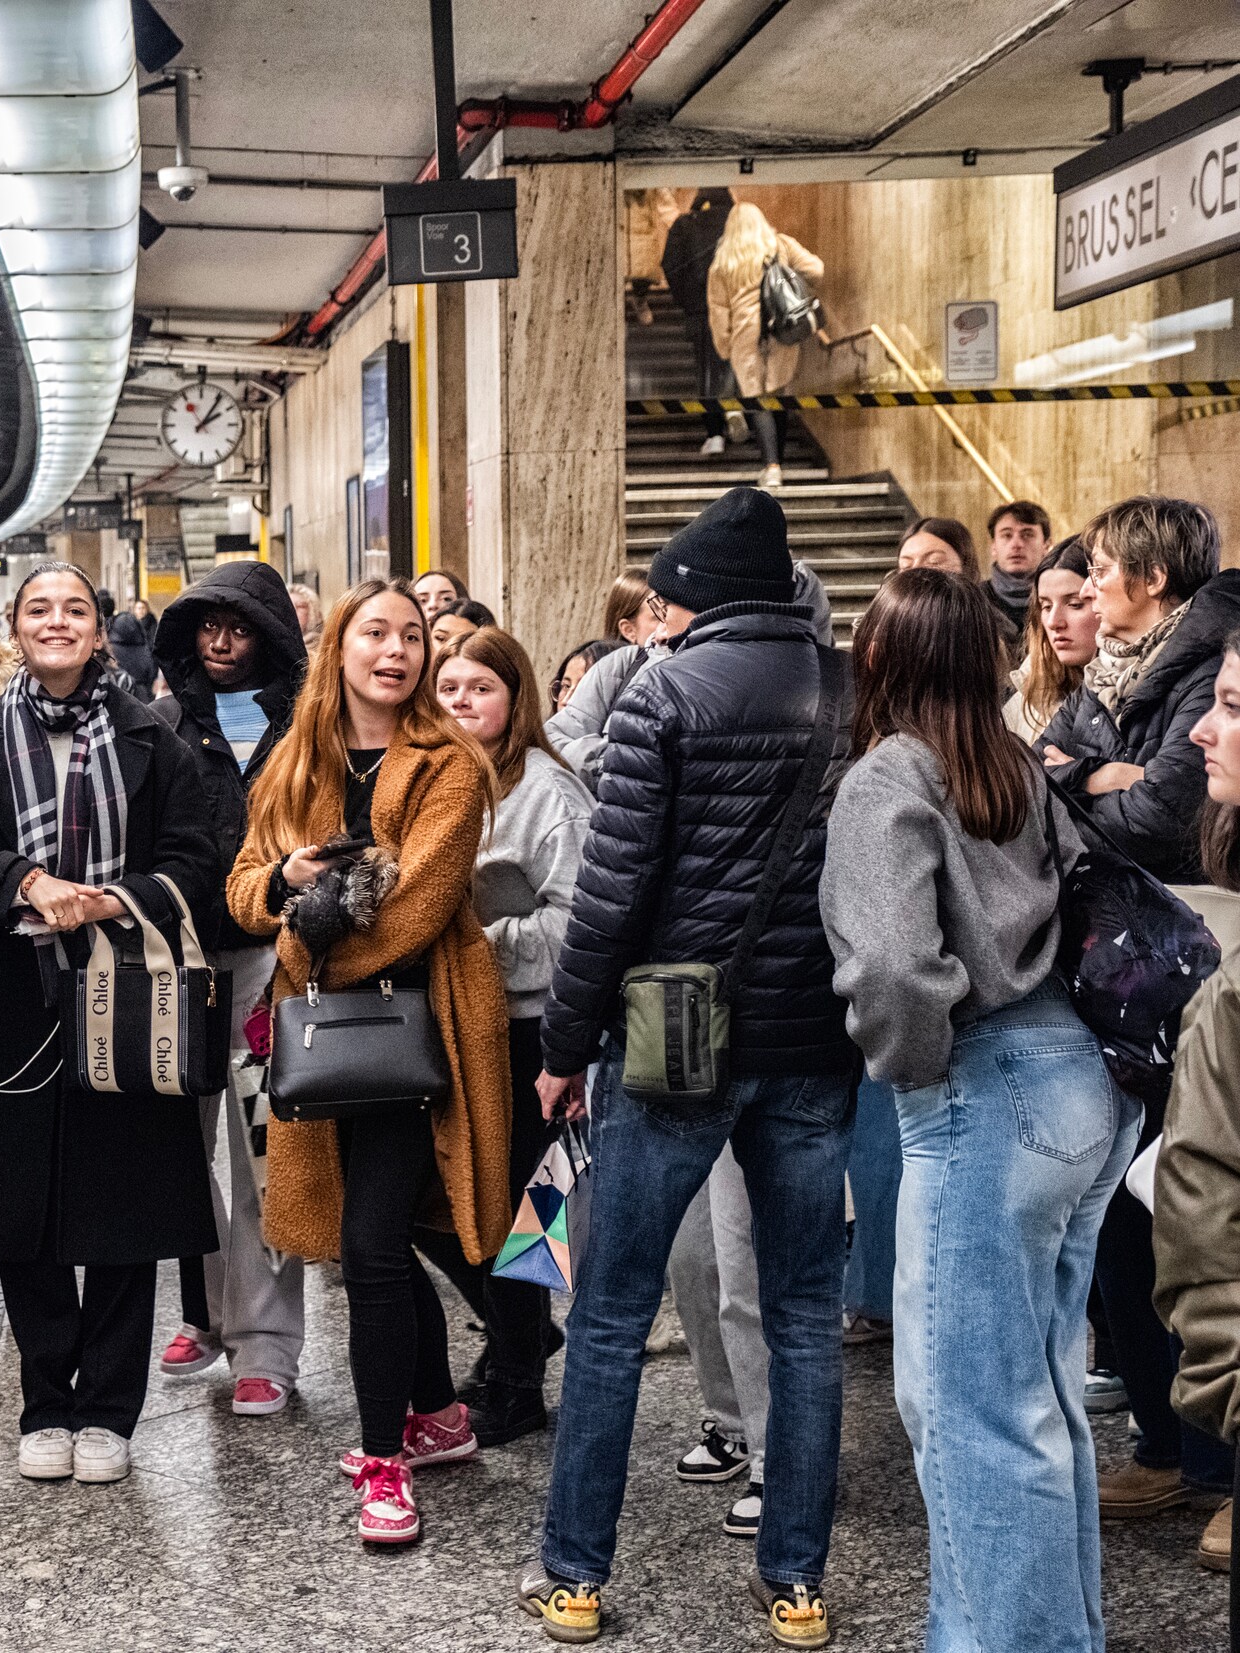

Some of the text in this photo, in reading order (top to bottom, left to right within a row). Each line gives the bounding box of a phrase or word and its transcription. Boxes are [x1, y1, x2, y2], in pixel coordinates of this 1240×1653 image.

[426, 222, 449, 232] Spoor
[426, 230, 445, 240] Voie
[1063, 175, 1166, 275] BRUSSEL
[454, 233, 472, 264] 3
[156, 970, 173, 1083] Chloé Chloé
[93, 1036, 110, 1082] Chloé
